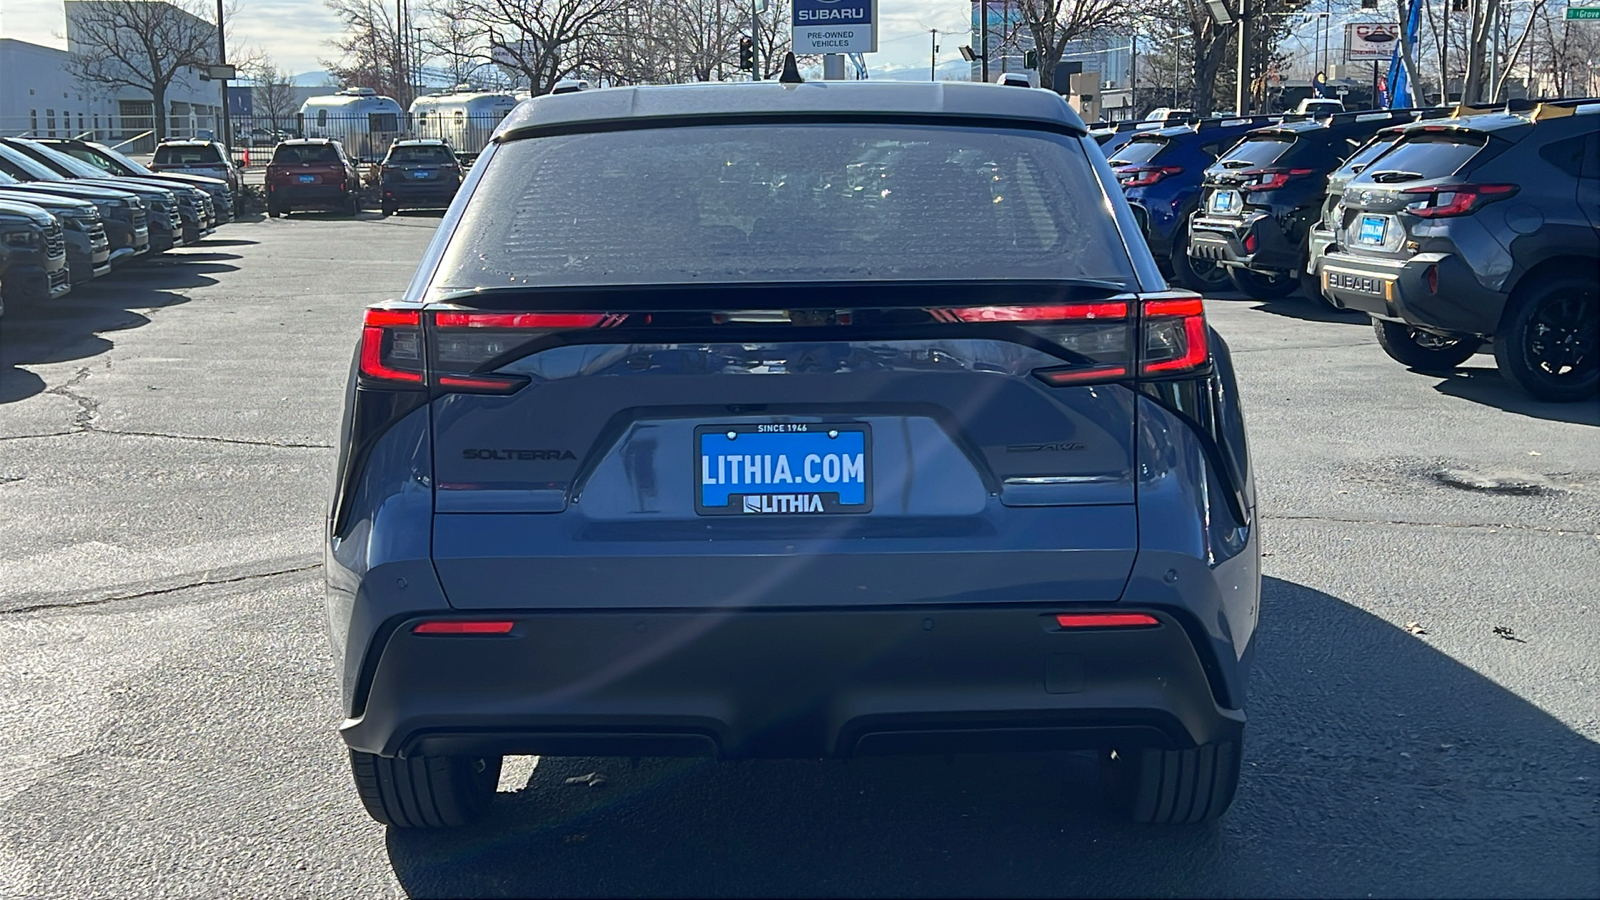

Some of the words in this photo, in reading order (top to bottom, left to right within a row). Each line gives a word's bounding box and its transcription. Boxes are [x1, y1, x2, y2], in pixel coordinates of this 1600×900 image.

[798, 8, 864, 20] SUBARU
[1580, 9, 1600, 18] Grove
[807, 31, 854, 39] PRE-OWNED
[811, 40, 850, 48] VEHICLES
[1330, 273, 1381, 294] SUBARU
[758, 424, 785, 433] SINCE
[787, 424, 808, 432] 1946
[462, 448, 577, 460] SOLTERRA
[702, 453, 864, 485] LITHIA.COM
[762, 494, 824, 513] LITHIA
